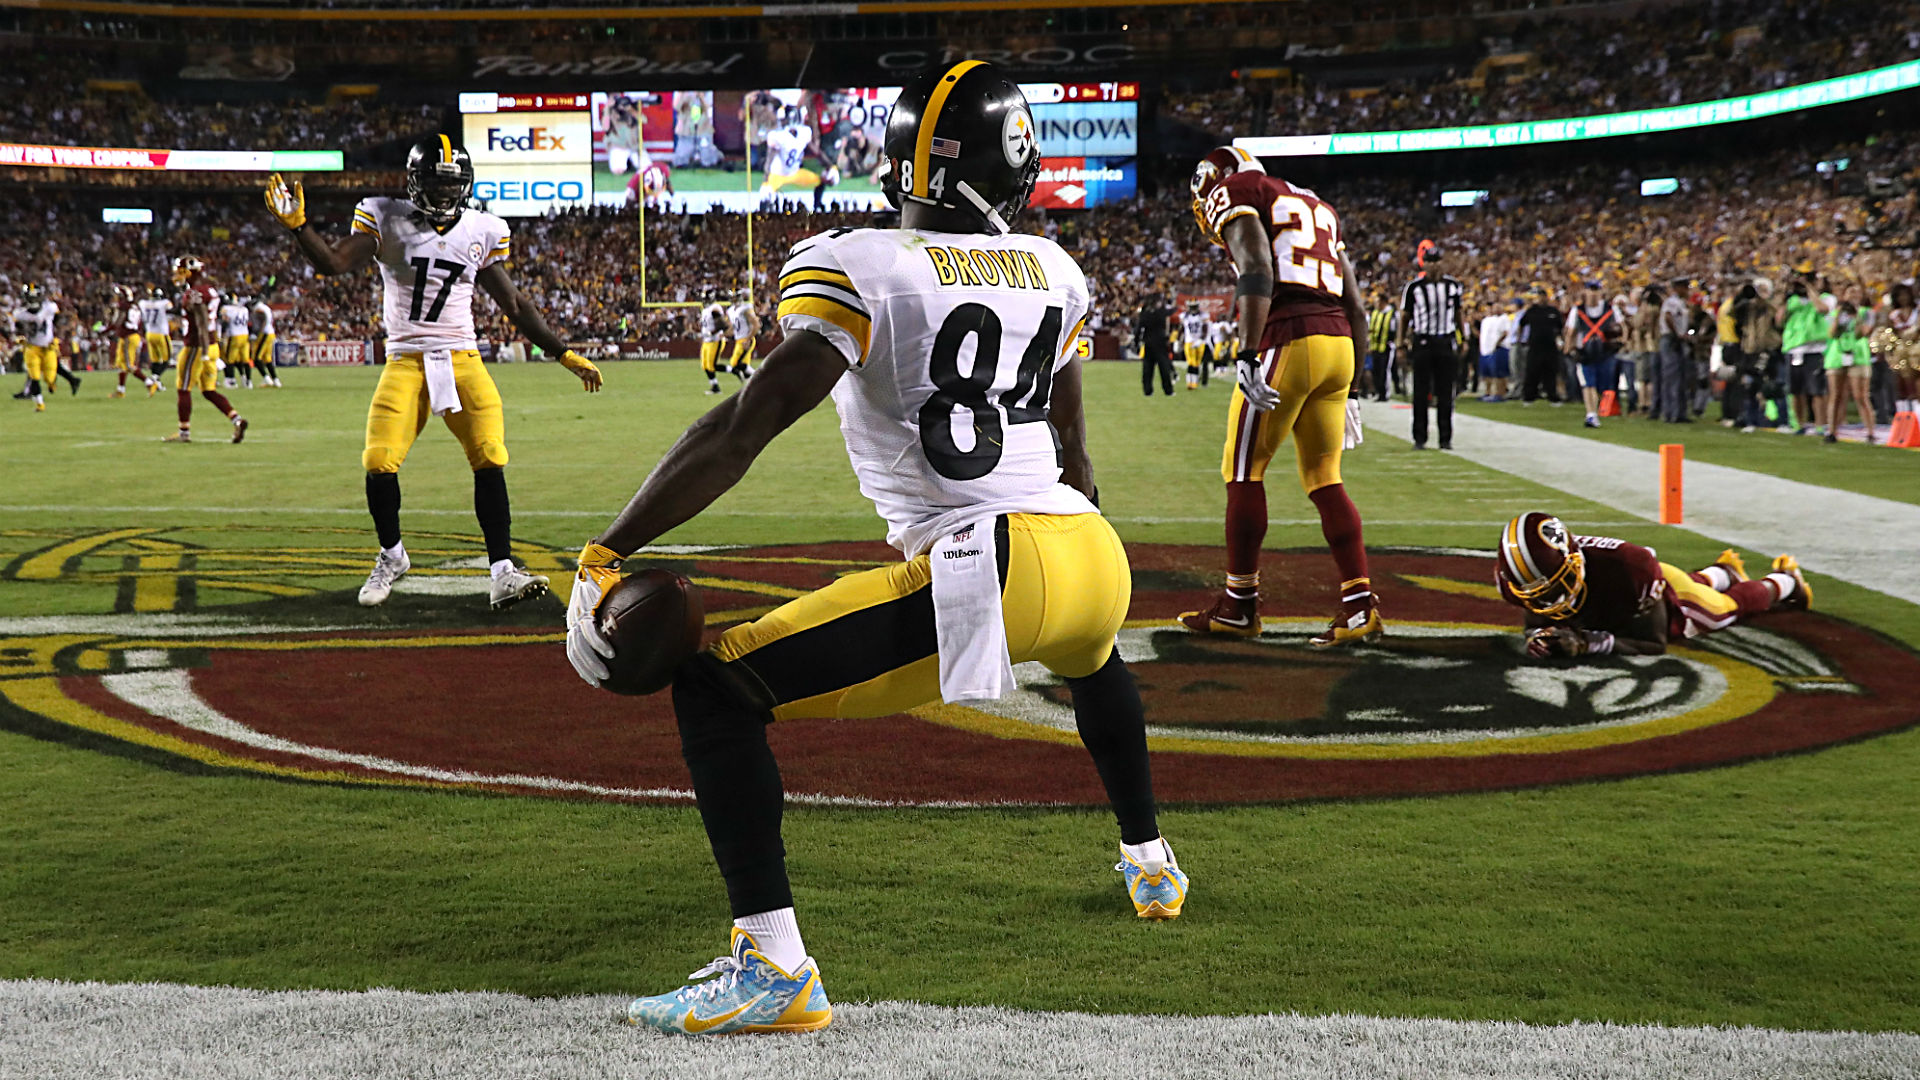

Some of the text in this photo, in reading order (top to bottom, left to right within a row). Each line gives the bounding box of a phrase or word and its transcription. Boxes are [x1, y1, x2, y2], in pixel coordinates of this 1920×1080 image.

[473, 54, 744, 79] FanDuel
[849, 104, 893, 127] OR
[487, 127, 565, 151] FedEx
[1041, 118, 1131, 141] INOVA
[1496, 126, 1518, 143] GET
[1520, 126, 1529, 141] A
[26, 147, 53, 165] FOR
[54, 148, 92, 167] YOUR
[93, 150, 154, 168] COUPON.
[902, 160, 946, 198] 84
[1069, 167, 1123, 181] America
[473, 181, 583, 201] GEICO
[1205, 185, 1232, 225] 23
[1271, 194, 1344, 297] 23
[925, 246, 1049, 291] BROWN
[408, 256, 466, 323] 17
[919, 302, 1063, 481] 84
[954, 531, 972, 544] NFL
[943, 549, 980, 560] Wilson
